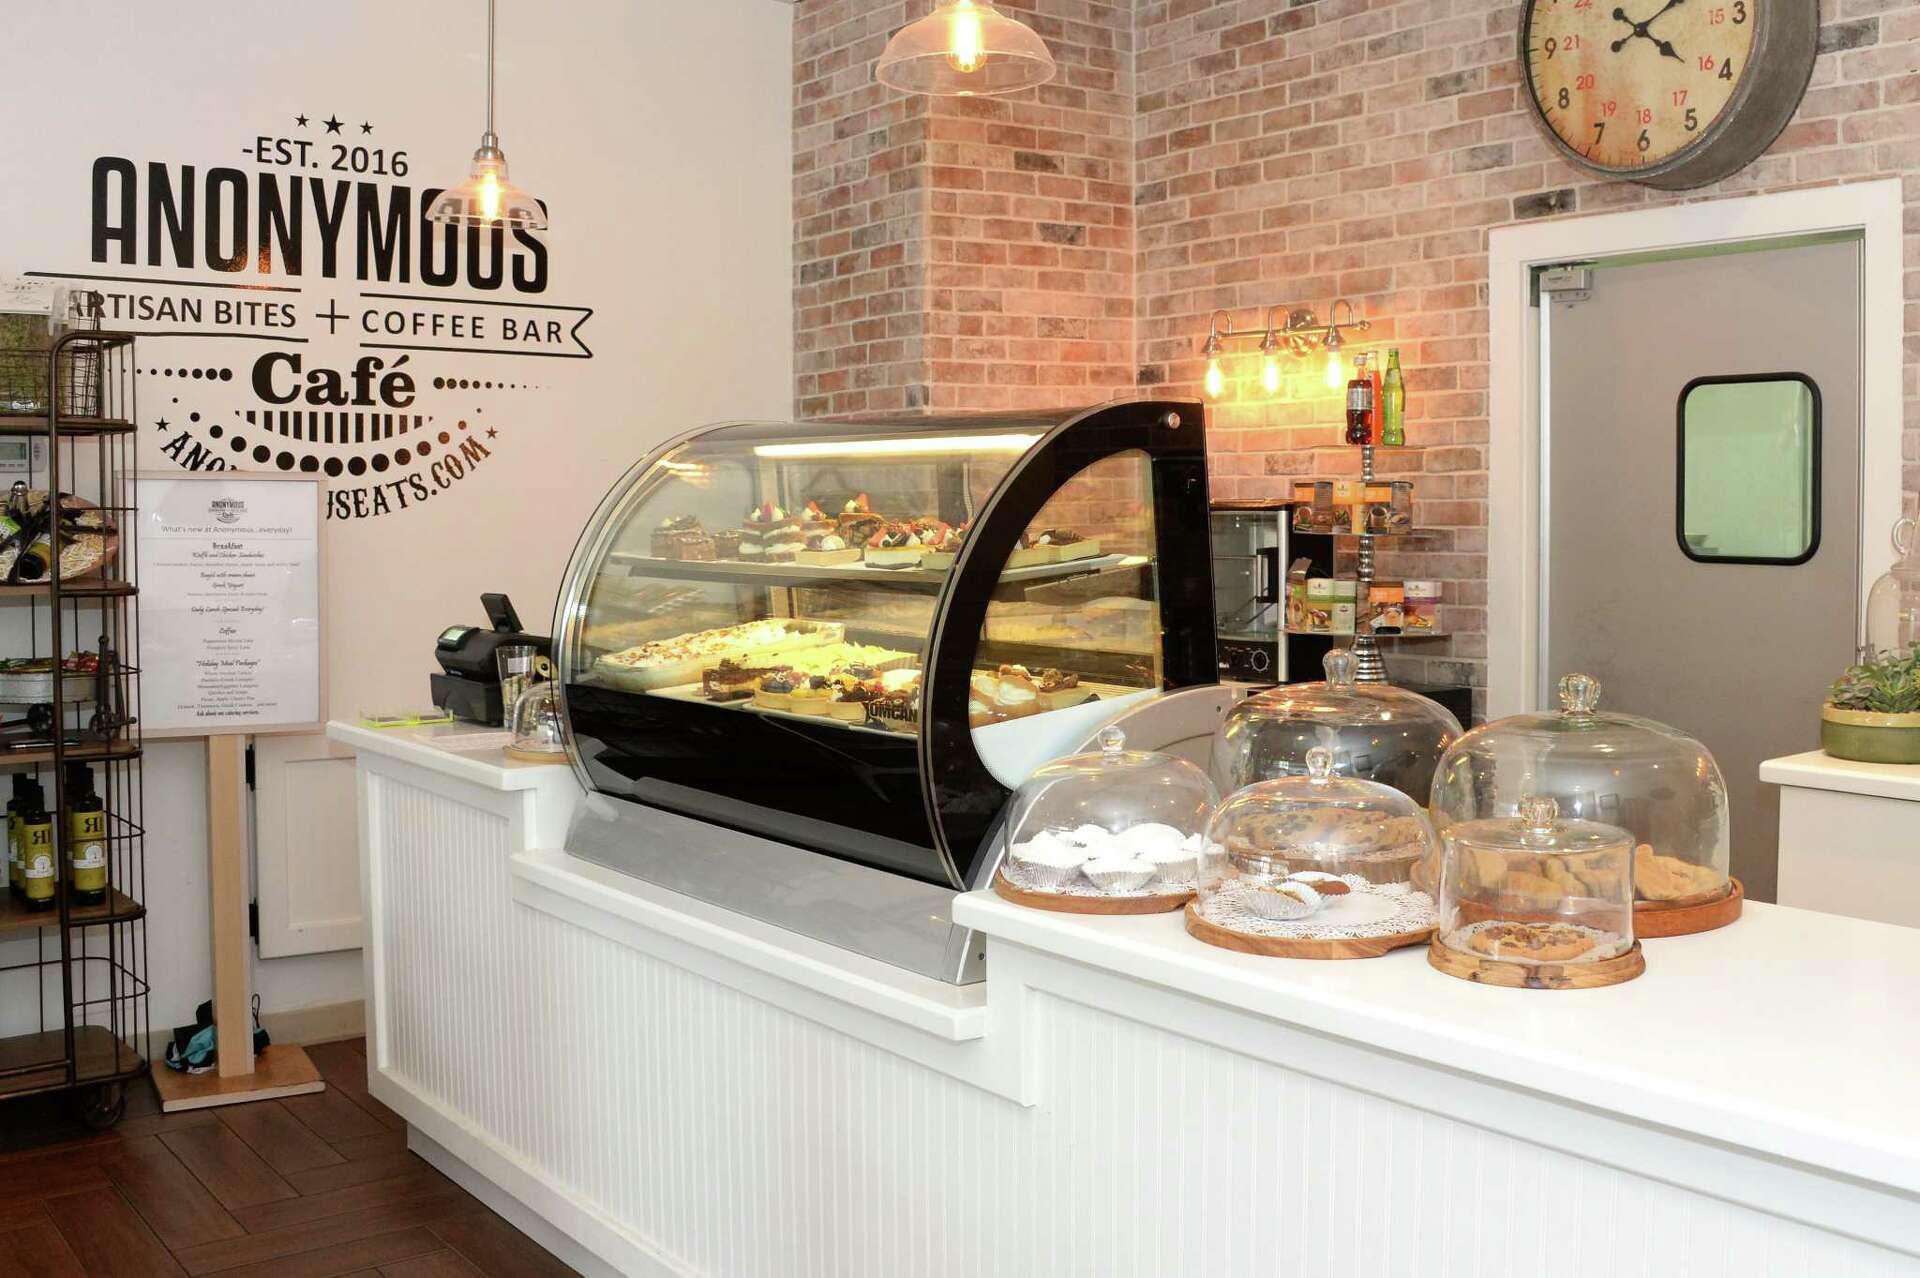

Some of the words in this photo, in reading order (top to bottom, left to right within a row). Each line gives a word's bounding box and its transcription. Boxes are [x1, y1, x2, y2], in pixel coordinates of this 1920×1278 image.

[1708, 9, 1725, 25] 15
[1732, 1, 1746, 24] 3
[1544, 37, 1557, 60] 9
[1563, 36, 1580, 50] 21
[1698, 55, 1714, 71] 16
[1718, 57, 1733, 80] 4
[1576, 74, 1595, 90] 20
[1558, 87, 1570, 109] 8
[1601, 101, 1617, 117] 19
[1672, 90, 1688, 107] 17
[1637, 108, 1651, 124] 18
[1684, 108, 1698, 131] 5
[1593, 122, 1605, 145] 7
[1637, 129, 1650, 151] 6
[331, 144, 409, 178] 2016
[91, 156, 548, 294] ANONYMOUS
[215, 300, 297, 328] BITES
[361, 308, 486, 340] COFFEE
[501, 318, 563, 344] BAR
[251, 351, 416, 409] Café
